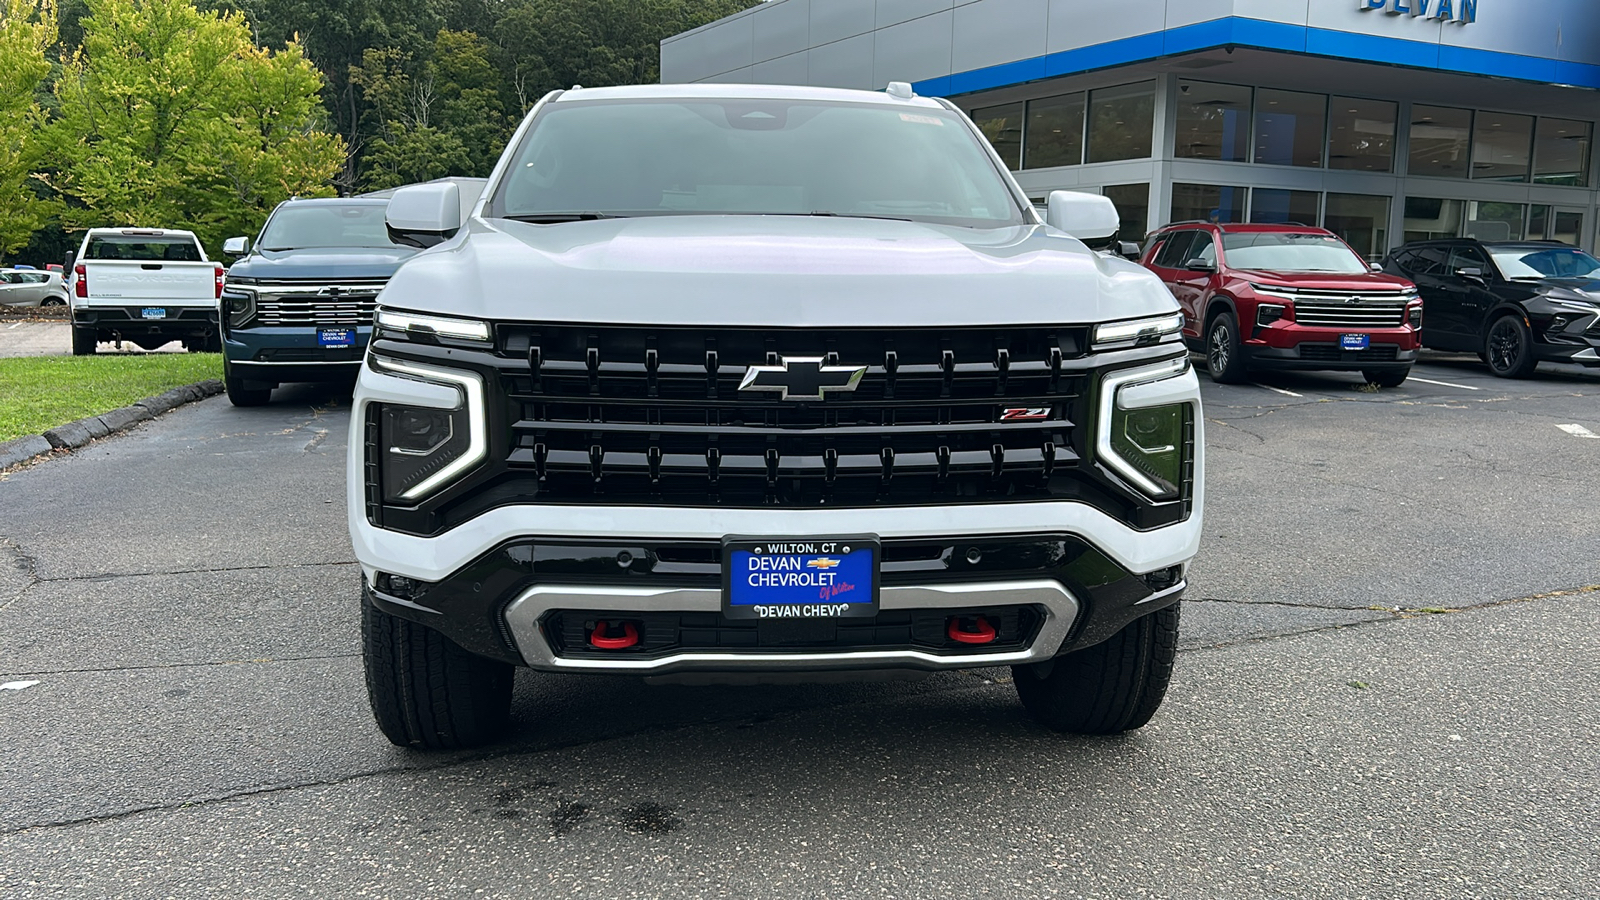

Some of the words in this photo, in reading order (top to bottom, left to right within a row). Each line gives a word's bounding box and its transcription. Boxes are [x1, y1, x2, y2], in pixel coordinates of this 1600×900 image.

[96, 275, 207, 283] CHEVROLET
[1000, 408, 1051, 420] Z71
[767, 543, 818, 554] WILTON,
[821, 543, 837, 553] CT
[748, 557, 801, 571] DEVAN
[748, 572, 837, 587] CHEVROLET
[819, 586, 830, 600] Of
[832, 582, 855, 596] Wilton
[759, 605, 800, 618] DEVAN
[803, 605, 843, 617] CHEVY
